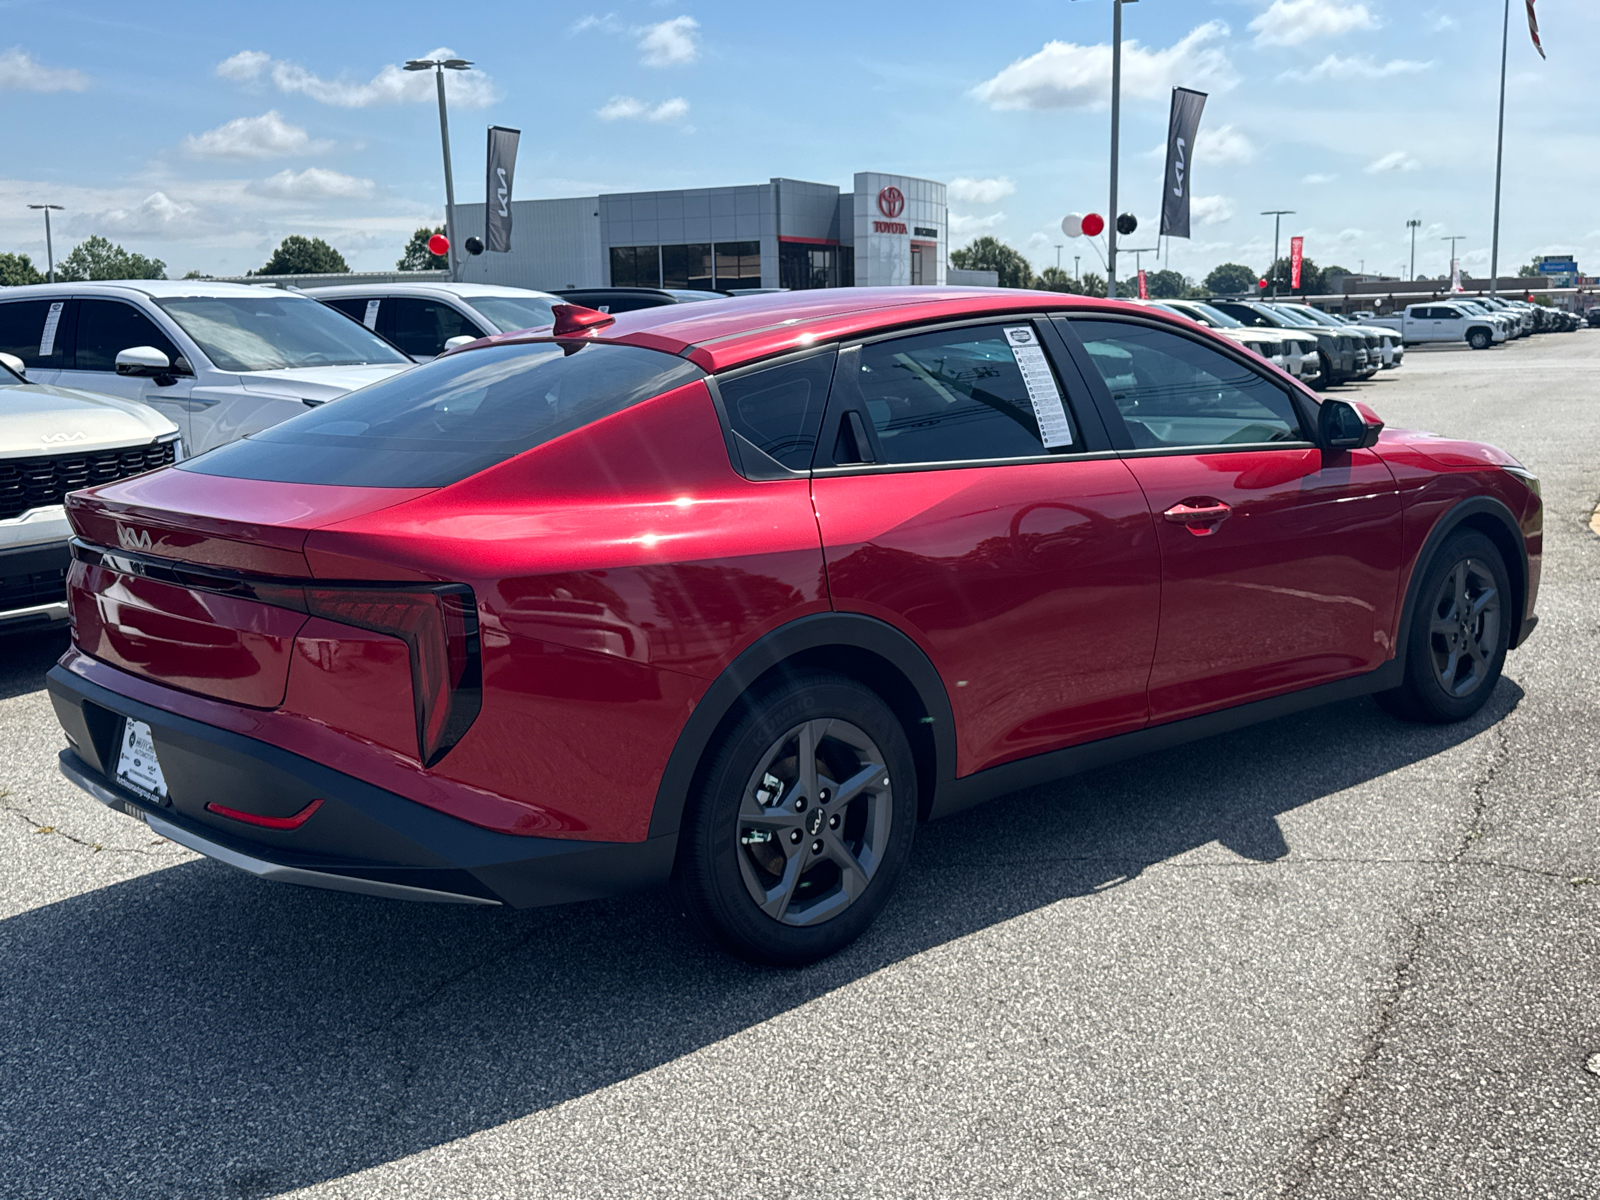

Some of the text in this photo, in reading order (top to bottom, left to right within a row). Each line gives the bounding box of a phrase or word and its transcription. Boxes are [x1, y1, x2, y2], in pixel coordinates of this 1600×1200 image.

[1173, 137, 1186, 198] KIA
[496, 167, 508, 218] KIA
[873, 220, 908, 235] TOYOTA
[1291, 248, 1300, 287] TOYOTA
[41, 431, 87, 443] KIA
[116, 526, 153, 550] KIA
[752, 695, 816, 748] KUMHO
